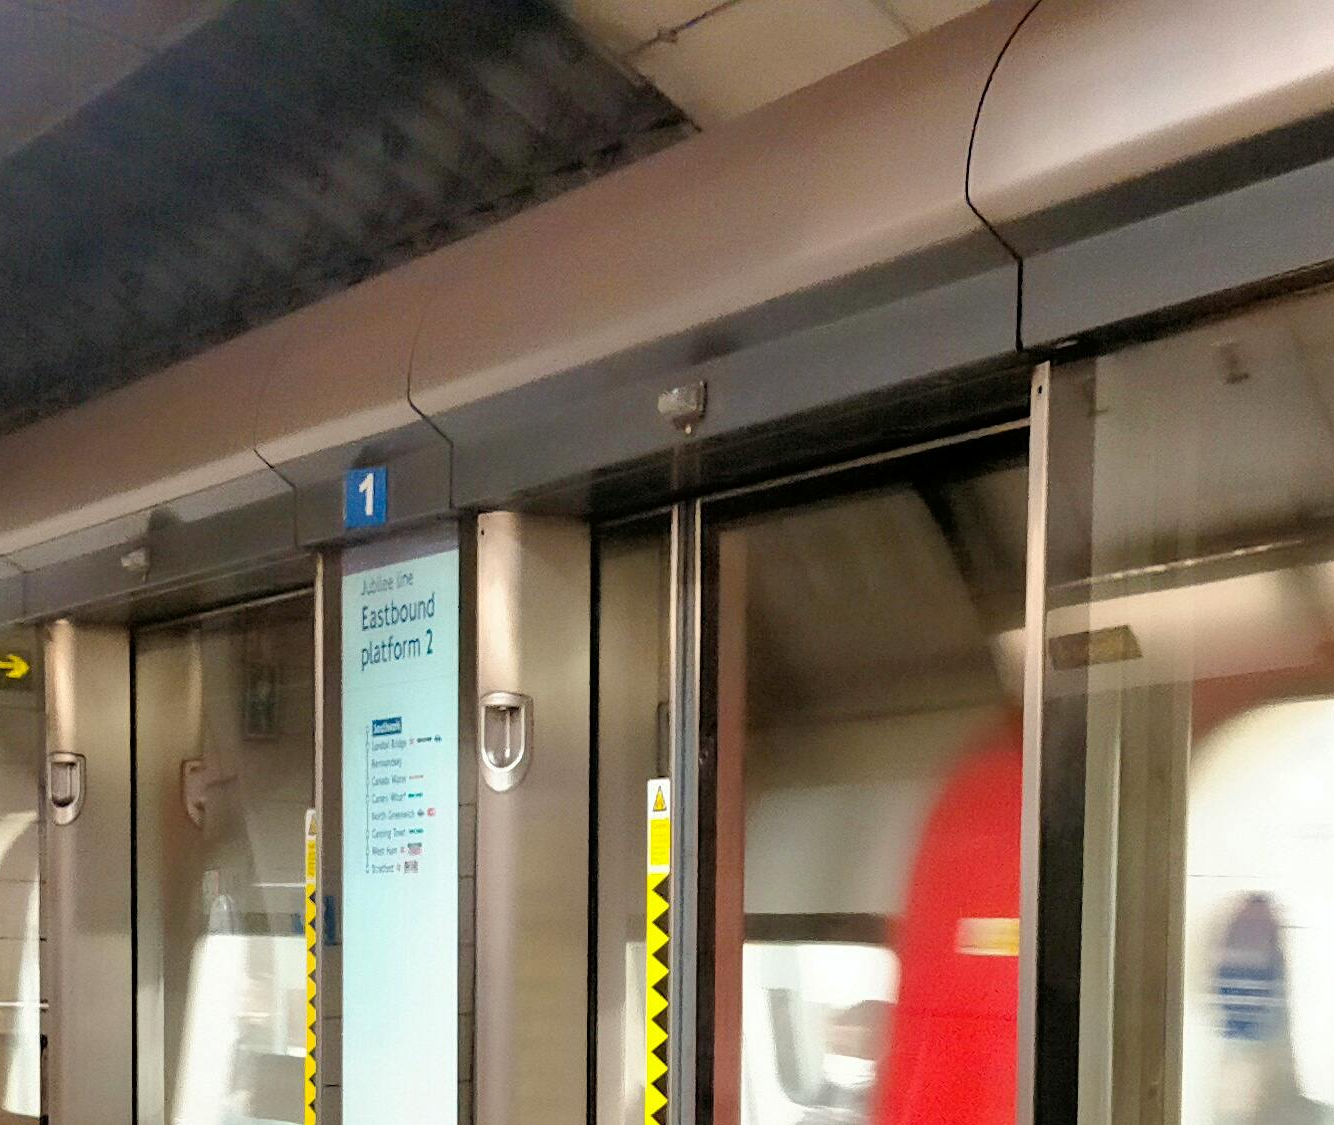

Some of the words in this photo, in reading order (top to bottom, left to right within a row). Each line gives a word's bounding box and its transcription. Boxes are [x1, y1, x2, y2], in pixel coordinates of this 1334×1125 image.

[359, 473, 374, 516] 1
[361, 575, 394, 596] Jubilee
[396, 570, 414, 588] line
[362, 591, 436, 631] Eastbound
[361, 635, 421, 672] platform
[426, 628, 434, 655] 2
